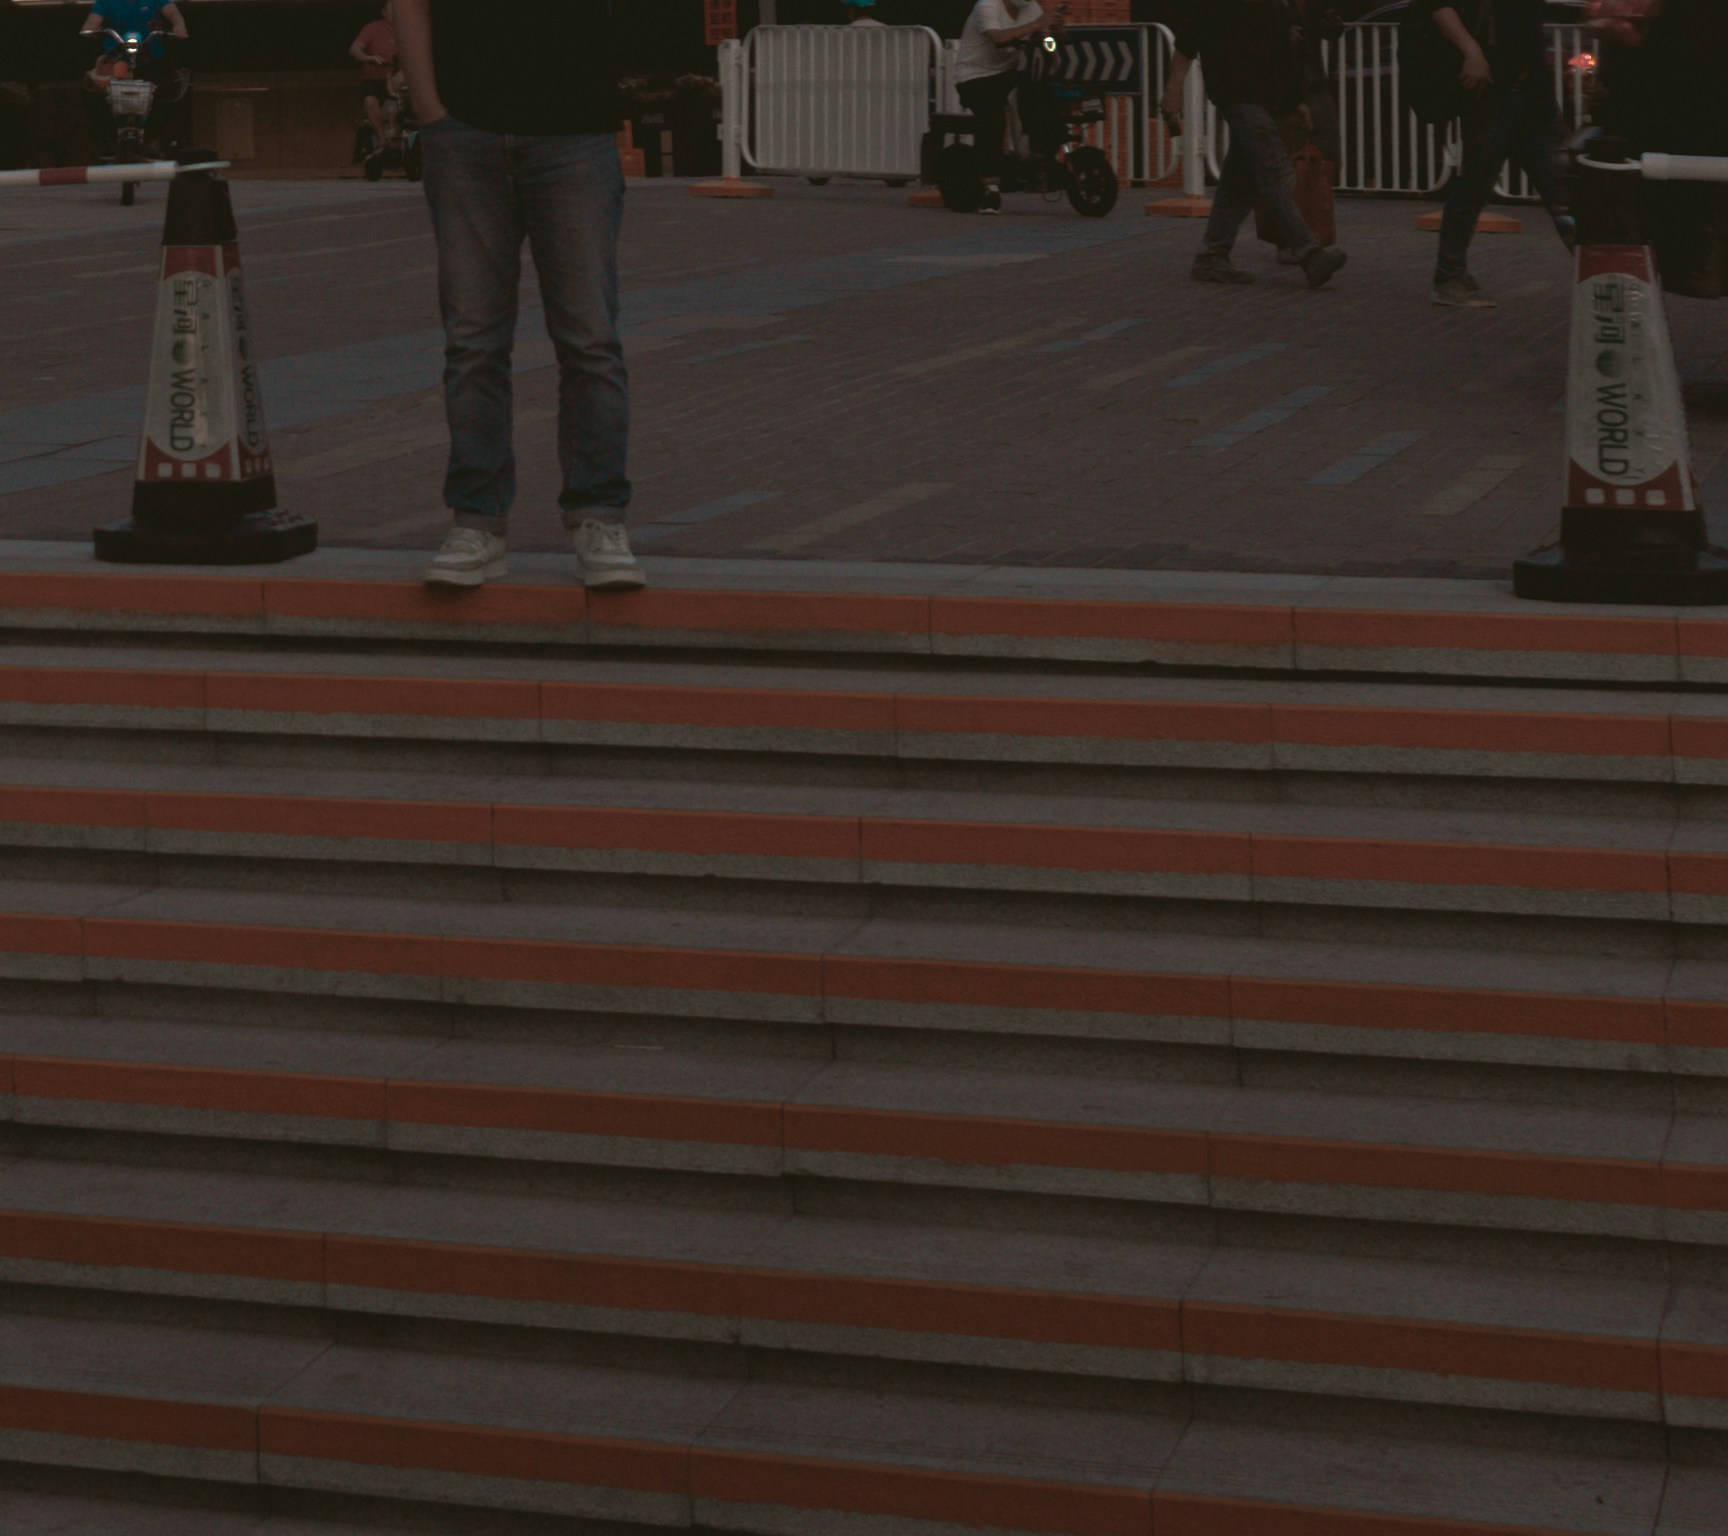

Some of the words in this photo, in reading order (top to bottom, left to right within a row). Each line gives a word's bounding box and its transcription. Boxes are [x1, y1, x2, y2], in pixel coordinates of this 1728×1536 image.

[1593, 282, 1627, 344] 星河
[169, 369, 197, 453] WORLD
[1596, 382, 1630, 477] WORLD
